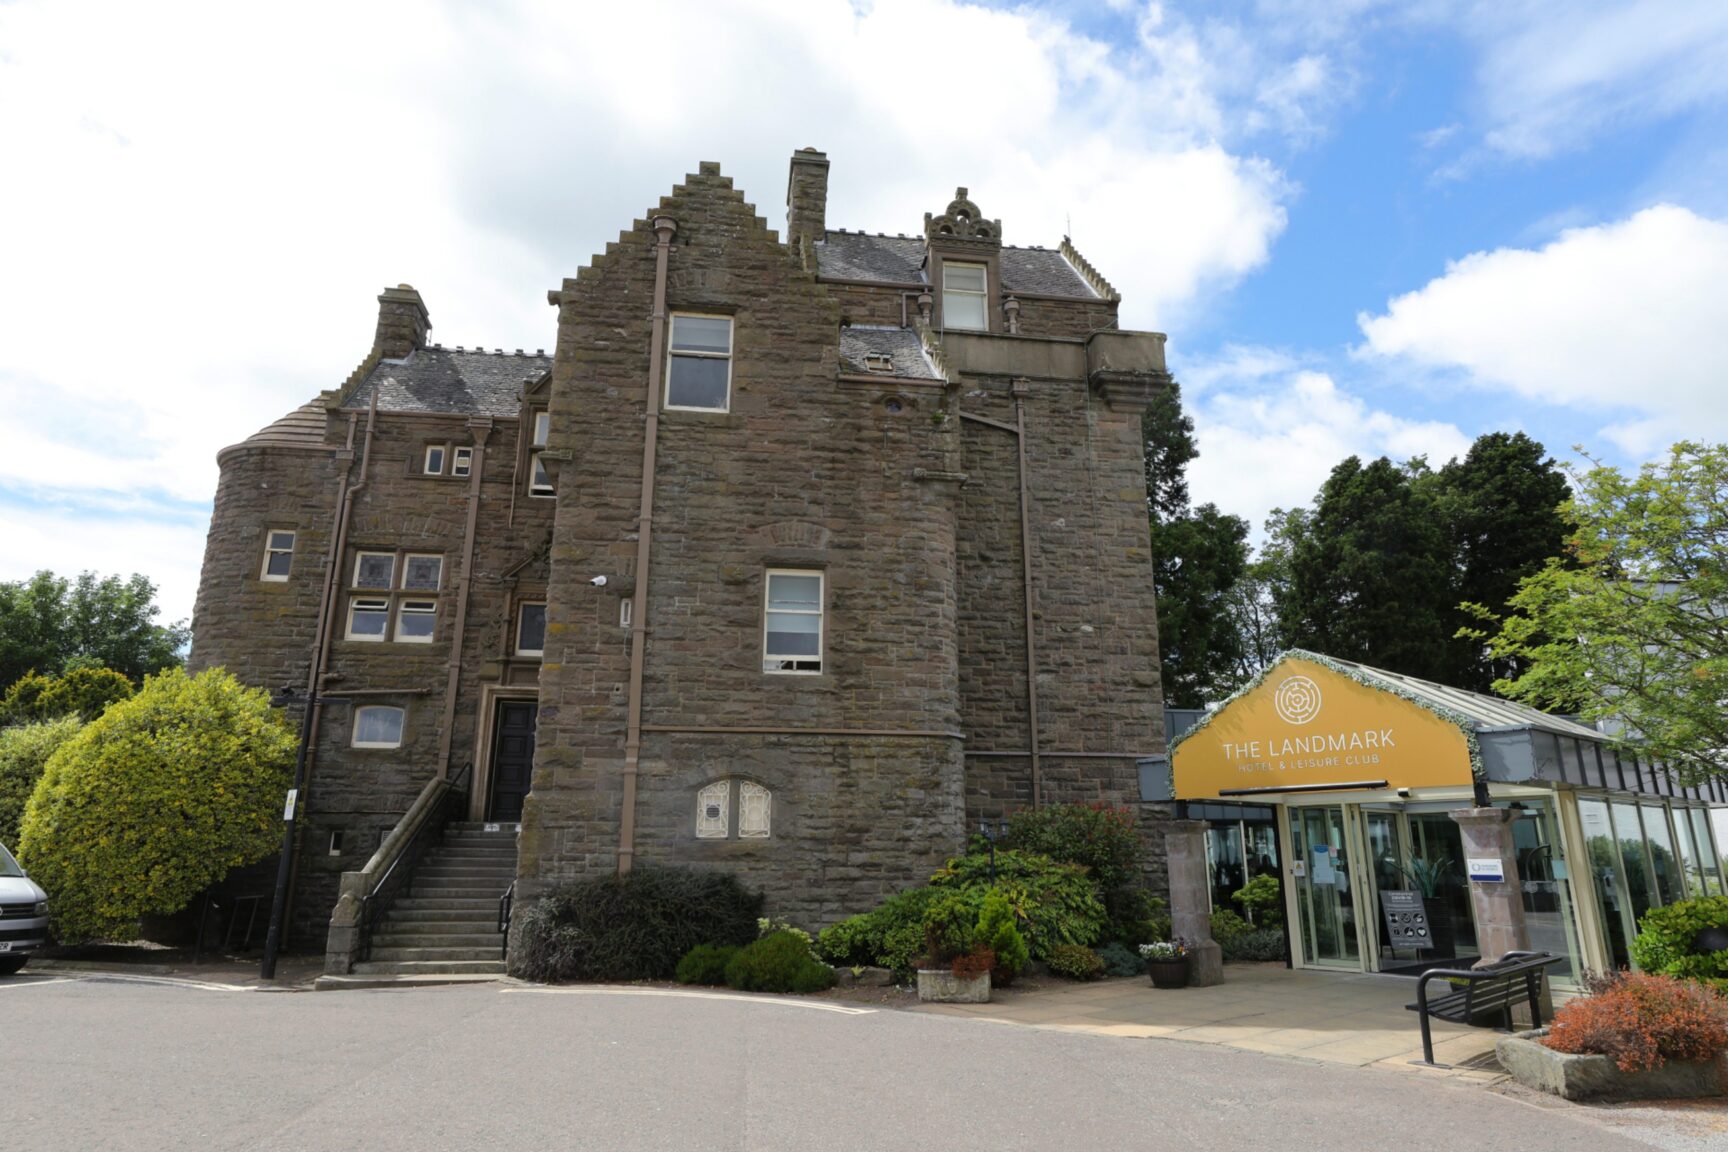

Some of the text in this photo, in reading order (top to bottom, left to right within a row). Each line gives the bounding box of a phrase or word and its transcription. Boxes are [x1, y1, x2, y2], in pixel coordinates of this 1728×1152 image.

[1222, 728, 1396, 760] THE LANDMARK
[1238, 754, 1380, 773] HOTEL & LEISURE CLUB
